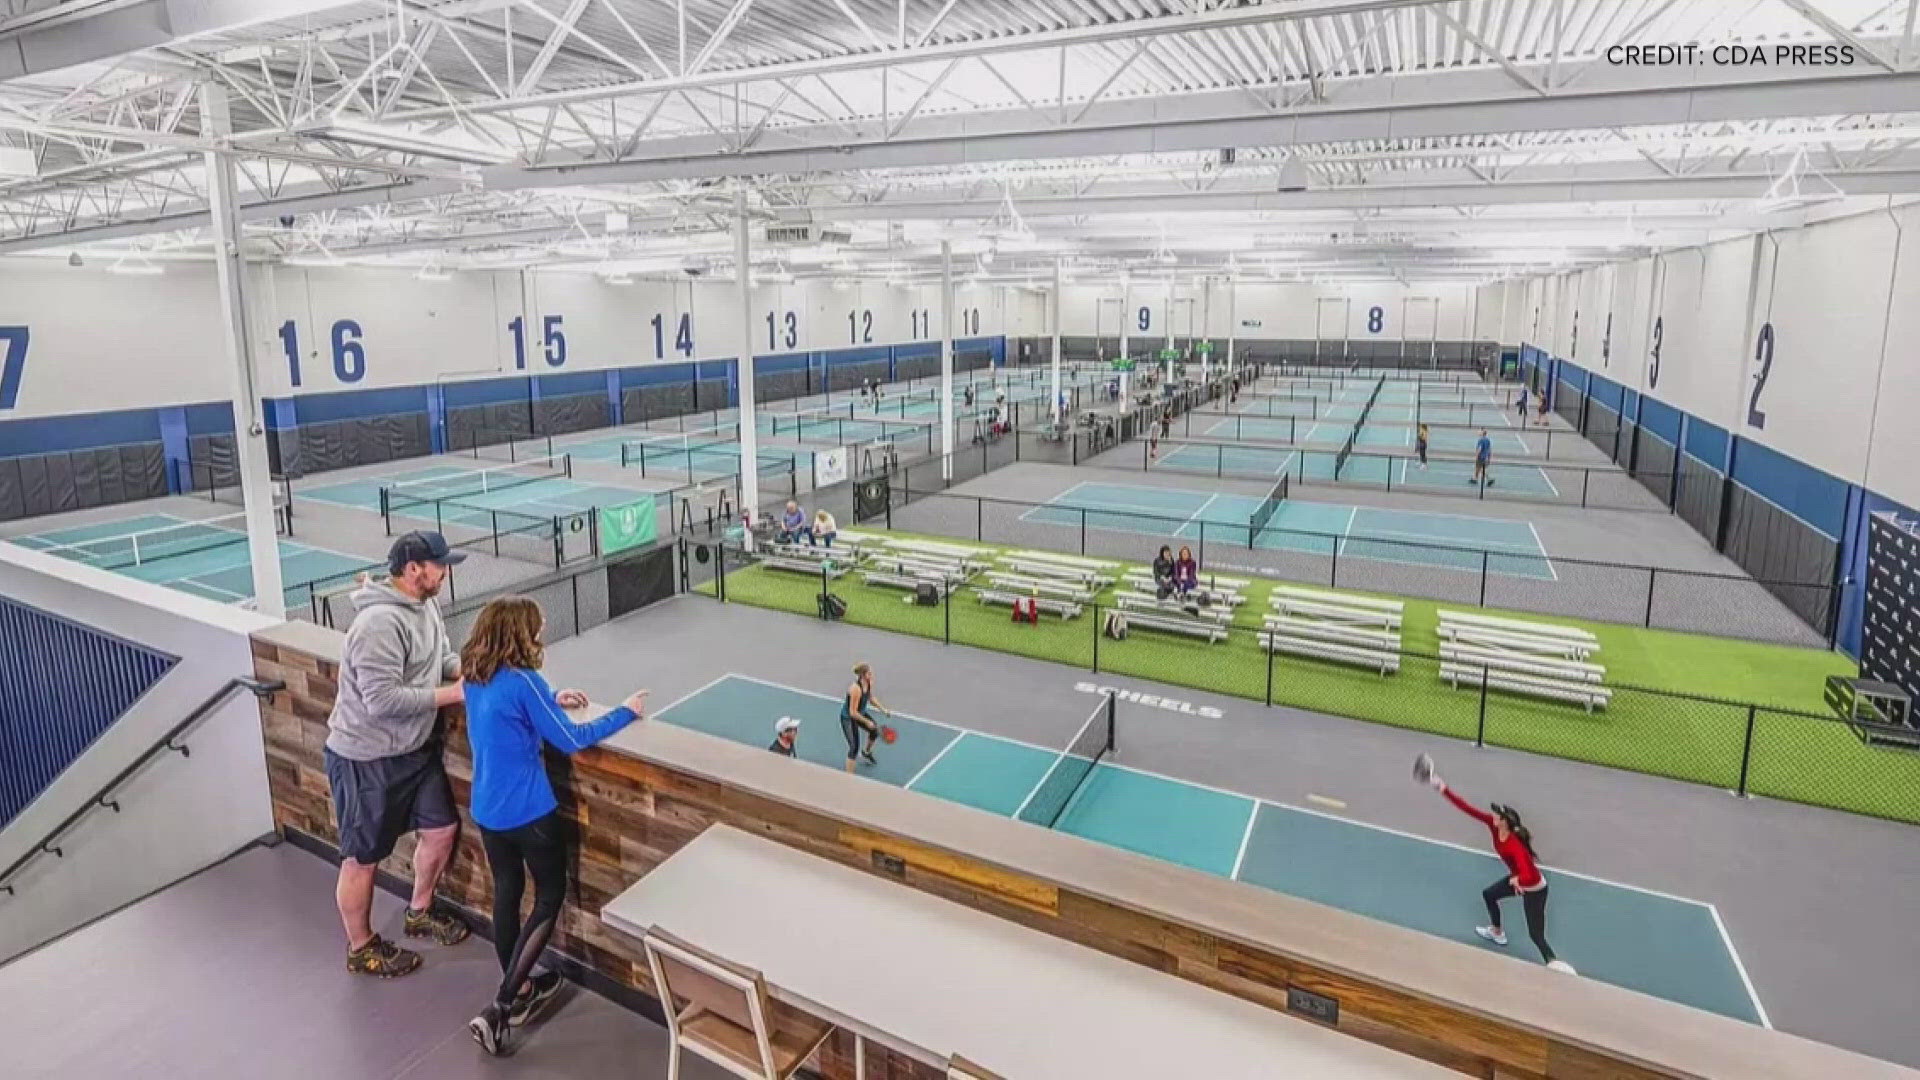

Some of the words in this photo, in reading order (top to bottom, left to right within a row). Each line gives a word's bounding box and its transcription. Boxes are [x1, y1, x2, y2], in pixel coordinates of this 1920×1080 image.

[650, 312, 693, 358] 14
[765, 311, 798, 351] 13
[848, 308, 873, 345] 12
[911, 308, 929, 340] 11
[963, 307, 980, 336] 10
[1138, 306, 1150, 331] 9
[1368, 306, 1384, 333] 8
[278, 318, 367, 387] 16
[508, 314, 567, 370] 15
[1650, 316, 1664, 389] 3
[1747, 322, 1776, 430] 2
[1074, 681, 1225, 719] SCHEELS
